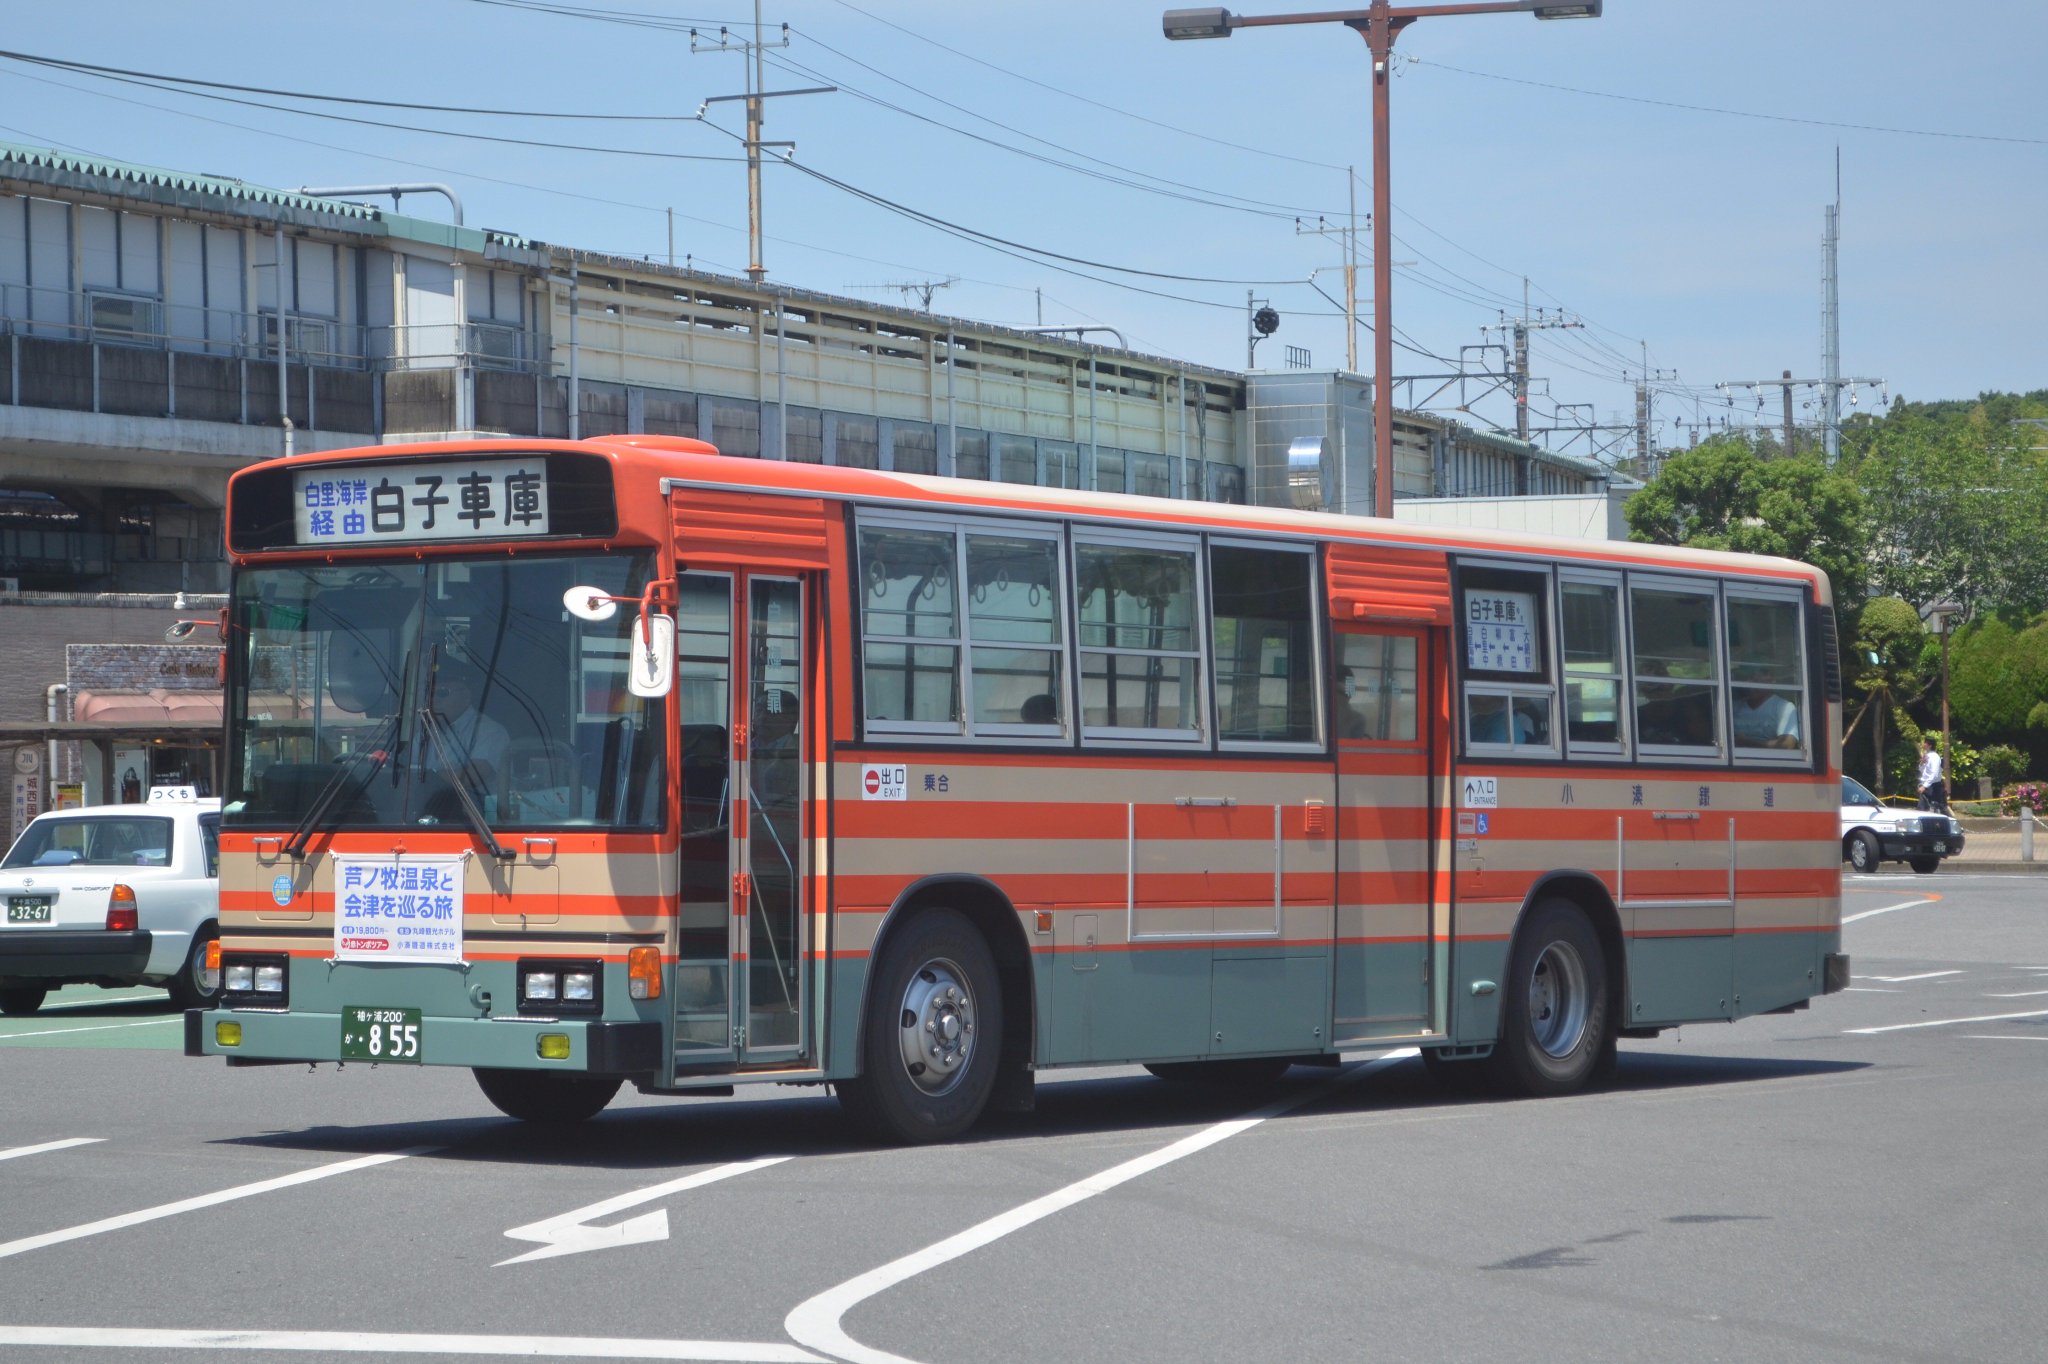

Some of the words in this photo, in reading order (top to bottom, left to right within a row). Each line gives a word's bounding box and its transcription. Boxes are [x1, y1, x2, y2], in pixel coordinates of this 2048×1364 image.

[305, 479, 367, 507] 白里海岸
[370, 469, 542, 533] 白子車庫
[310, 509, 365, 536] 経由
[1471, 597, 1516, 622] 白子車庫
[881, 767, 905, 785] 出口
[924, 774, 949, 792] 乗合
[153, 788, 189, 799] つくも
[884, 787, 901, 797] EXIT
[1477, 780, 1494, 795] 入口
[1474, 796, 1496, 805] ENTRANCE
[344, 866, 453, 892] 芦ノ牧温泉と
[16, 905, 49, 919] 32-67
[344, 894, 453, 919] 会津を巡る旅
[344, 1033, 353, 1045] か
